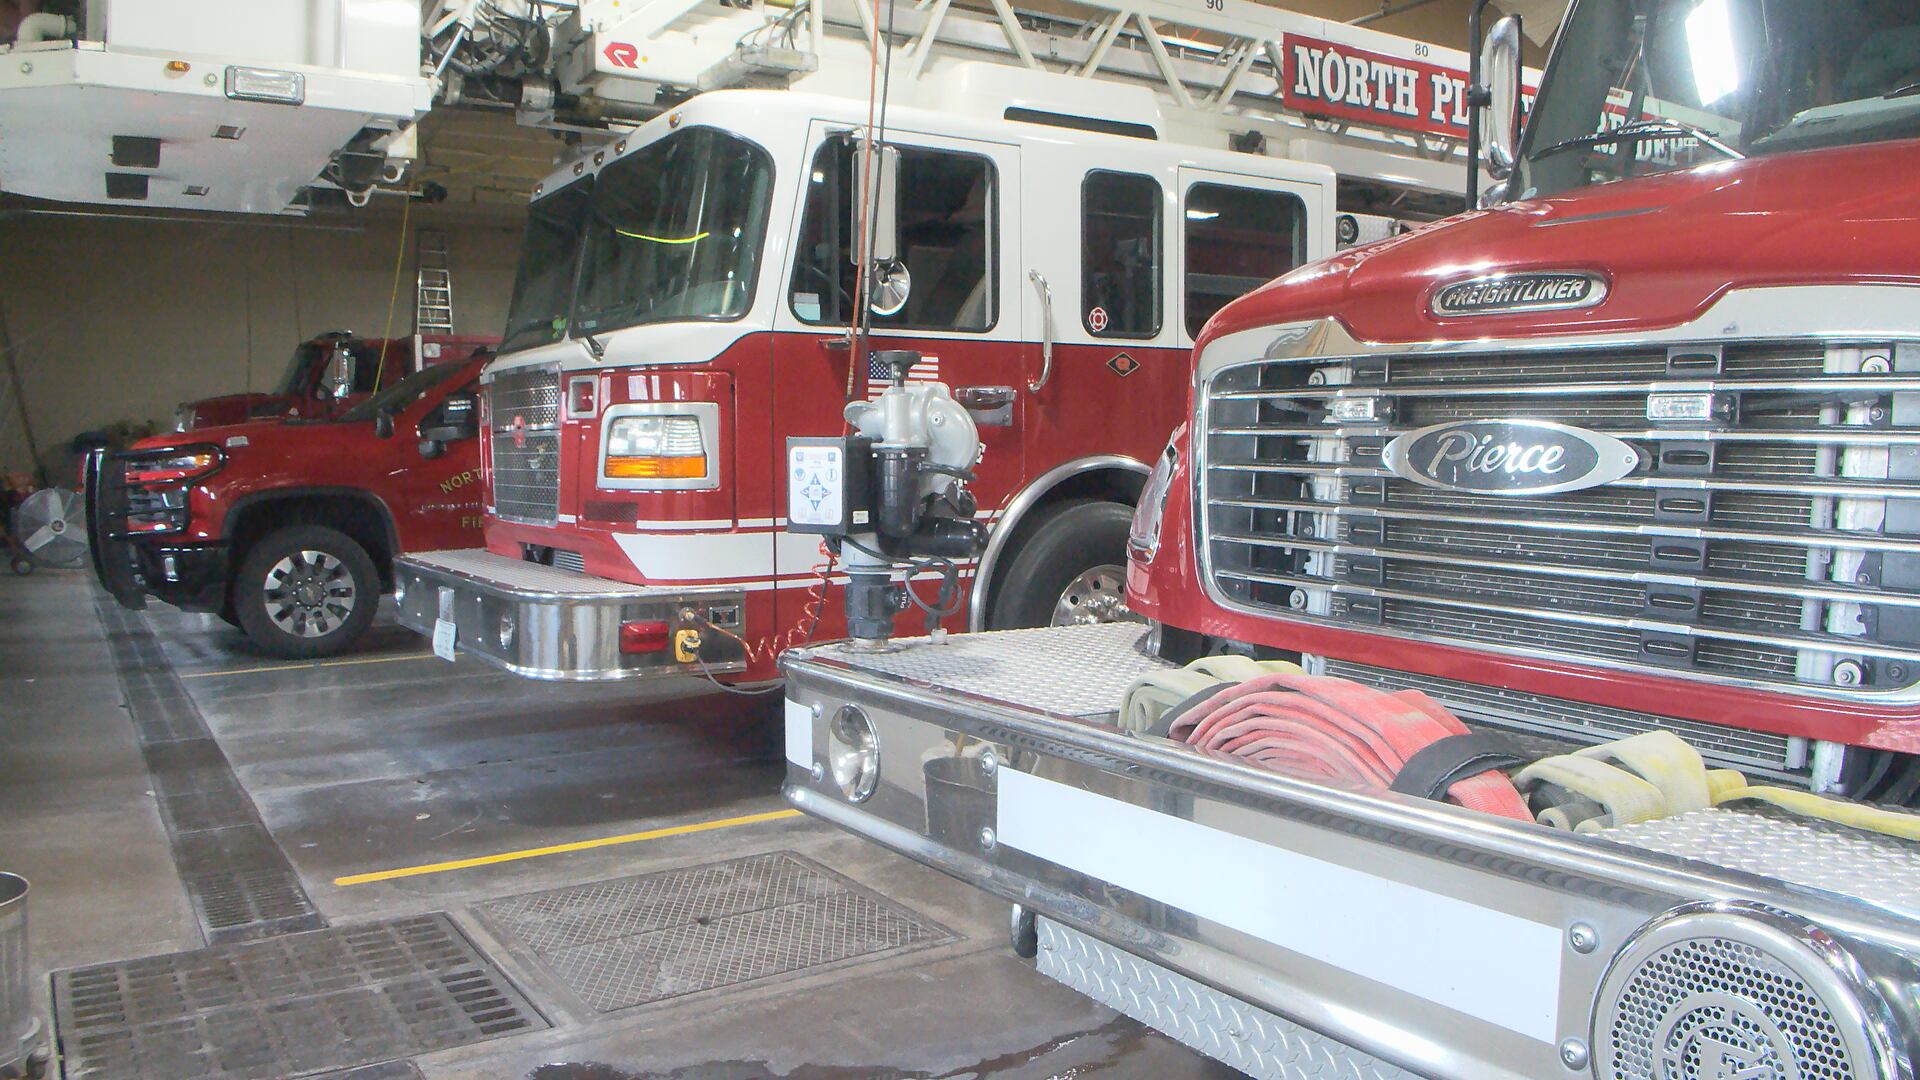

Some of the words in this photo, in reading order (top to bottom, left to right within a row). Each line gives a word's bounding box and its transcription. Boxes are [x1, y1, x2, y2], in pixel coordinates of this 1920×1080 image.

[1206, 0, 1224, 12] 90
[1414, 43, 1429, 57] 80
[1293, 45, 1419, 117] NORTH
[1431, 71, 1470, 126] PL
[1444, 278, 1586, 307] FREIGHTLINER
[1427, 430, 1567, 478] Pierce
[439, 467, 484, 495] NORT
